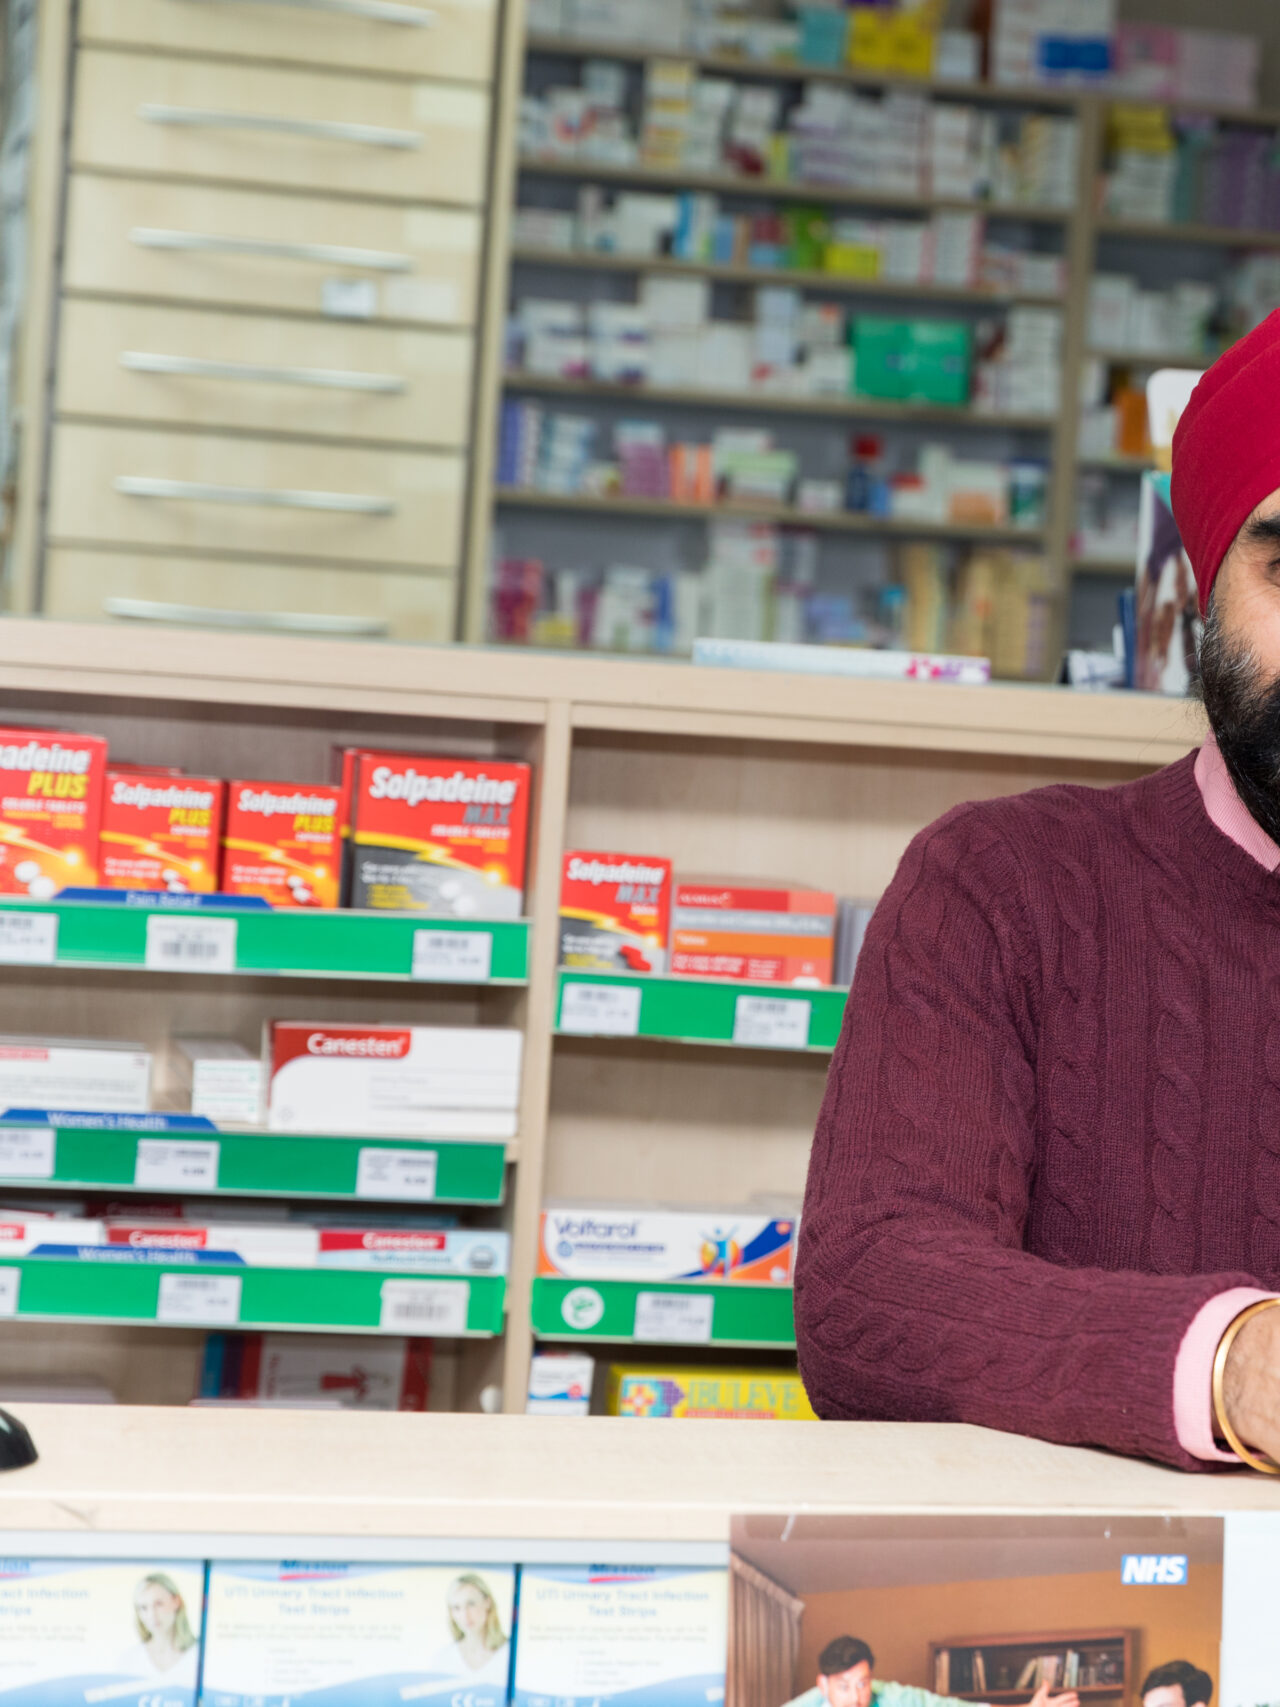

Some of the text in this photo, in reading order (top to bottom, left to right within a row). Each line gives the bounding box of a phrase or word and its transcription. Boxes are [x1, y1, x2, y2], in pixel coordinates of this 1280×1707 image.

[27, 770, 90, 799] PLUS
[369, 766, 518, 807] Solpadeine
[111, 781, 214, 810] Solpadeine
[238, 789, 337, 817] Solpadeine
[168, 807, 212, 828] PLUS
[293, 814, 336, 833] PLUS
[462, 804, 513, 826] MAX
[567, 857, 665, 886] Solpadeine
[160, 892, 202, 907] Relief
[614, 885, 661, 905] MAX
[307, 1033, 403, 1057] Canesten
[47, 1111, 168, 1129] Women's Health
[554, 1217, 637, 1239] Voltarol
[129, 1230, 203, 1249] Canesten
[362, 1232, 438, 1250] Canesten
[77, 1245, 198, 1263] Women's Health
[687, 1379, 800, 1409] IBULEVE
[1121, 1556, 1185, 1584] NHS
[27, 1587, 90, 1601] Infection
[253, 1587, 304, 1603] Urinary
[308, 1587, 341, 1600] Tract
[345, 1588, 405, 1601] Infection
[562, 1589, 612, 1605] Urinary
[616, 1589, 649, 1602] Tract
[653, 1590, 710, 1603] Infection
[278, 1604, 351, 1619] Test Strips
[588, 1605, 657, 1620] Test Strips
